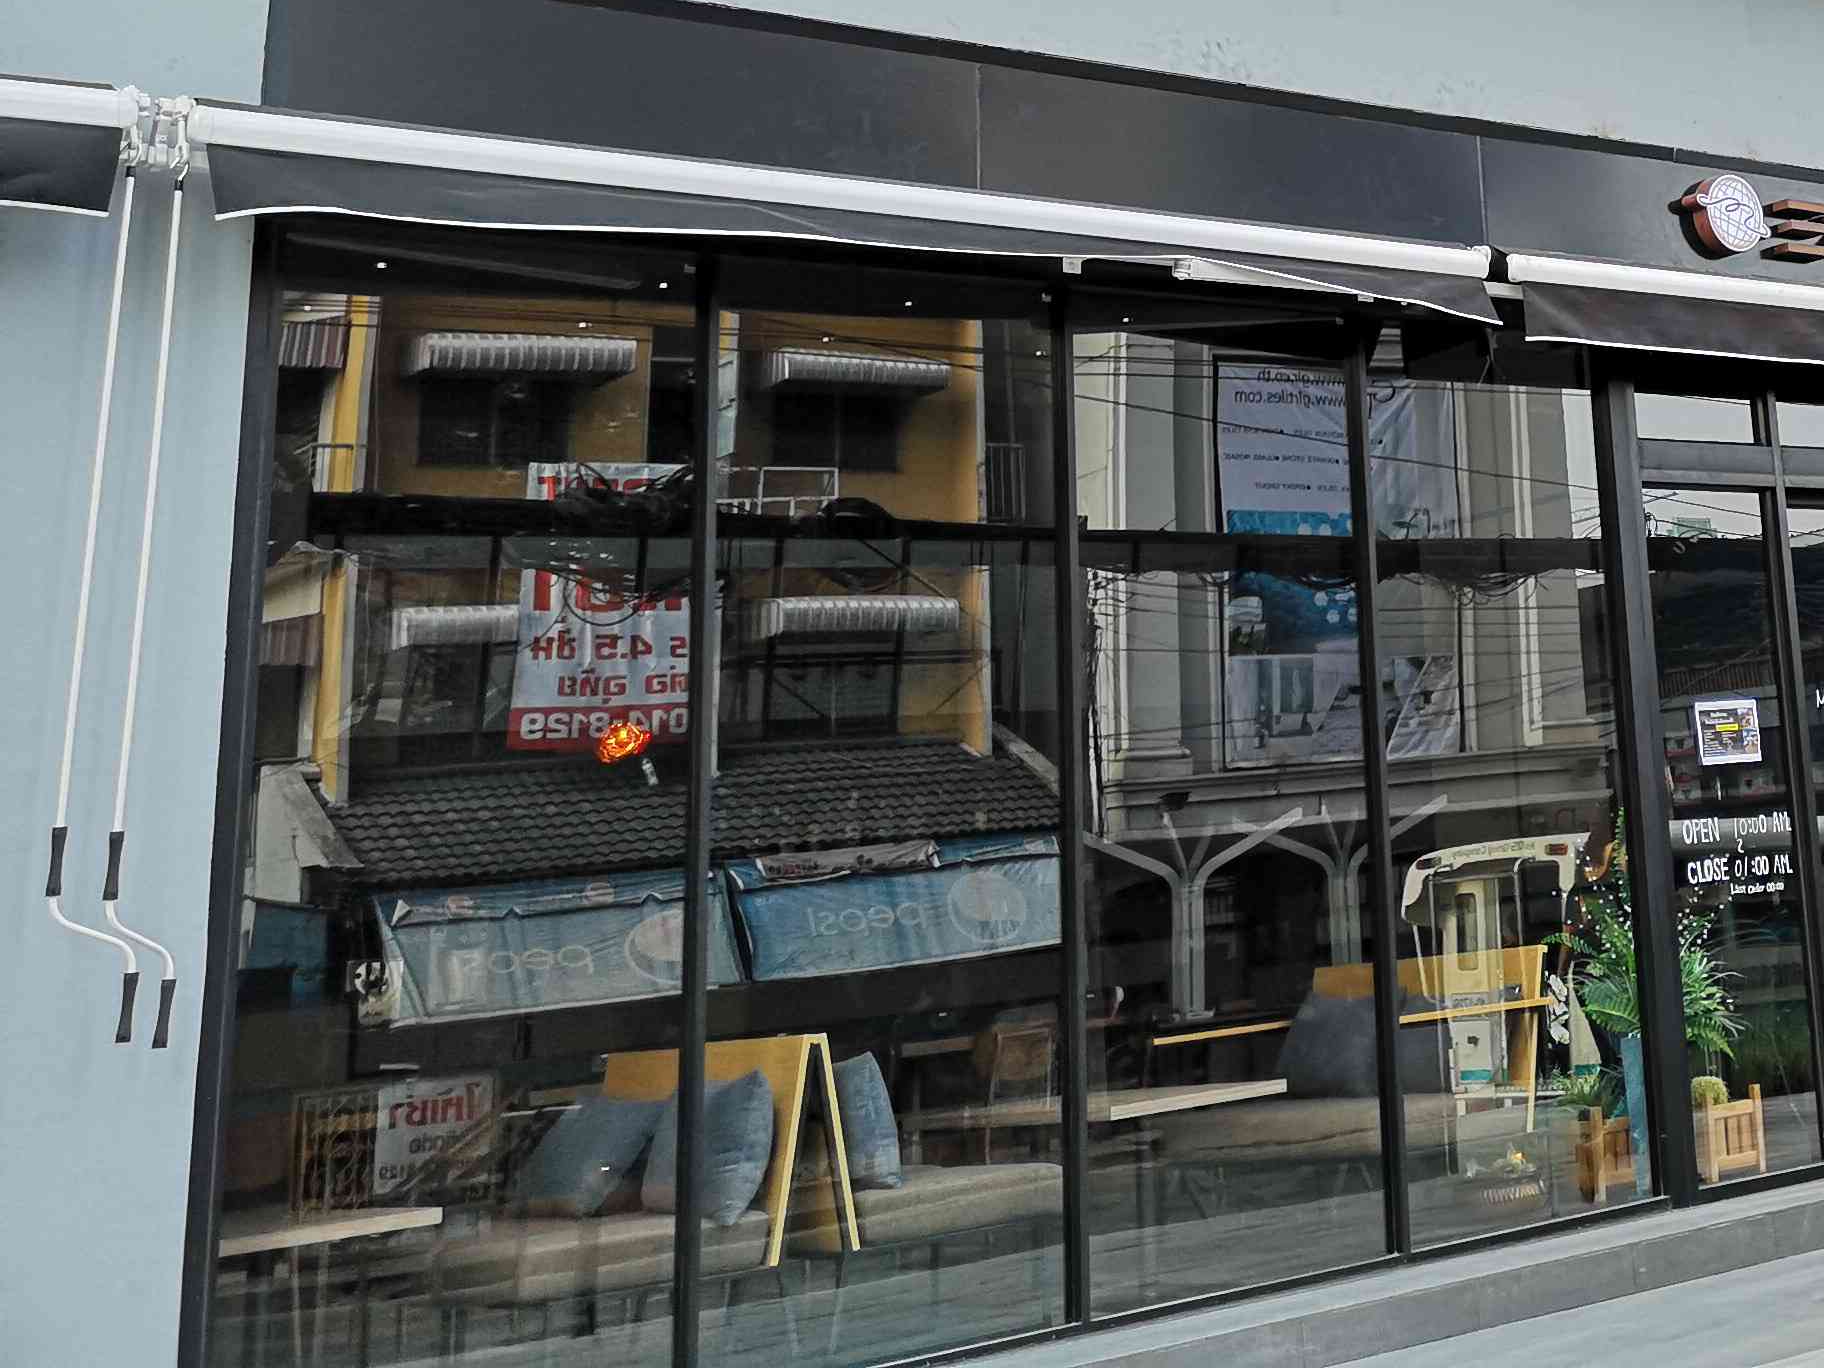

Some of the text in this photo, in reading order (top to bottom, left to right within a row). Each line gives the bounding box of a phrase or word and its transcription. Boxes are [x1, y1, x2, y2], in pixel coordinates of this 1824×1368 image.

[1682, 816, 1721, 845] OPEN
[1734, 814, 1768, 839] 10:00
[1687, 857, 1730, 885] CLOSE
[1734, 855, 1770, 878] 01:00
